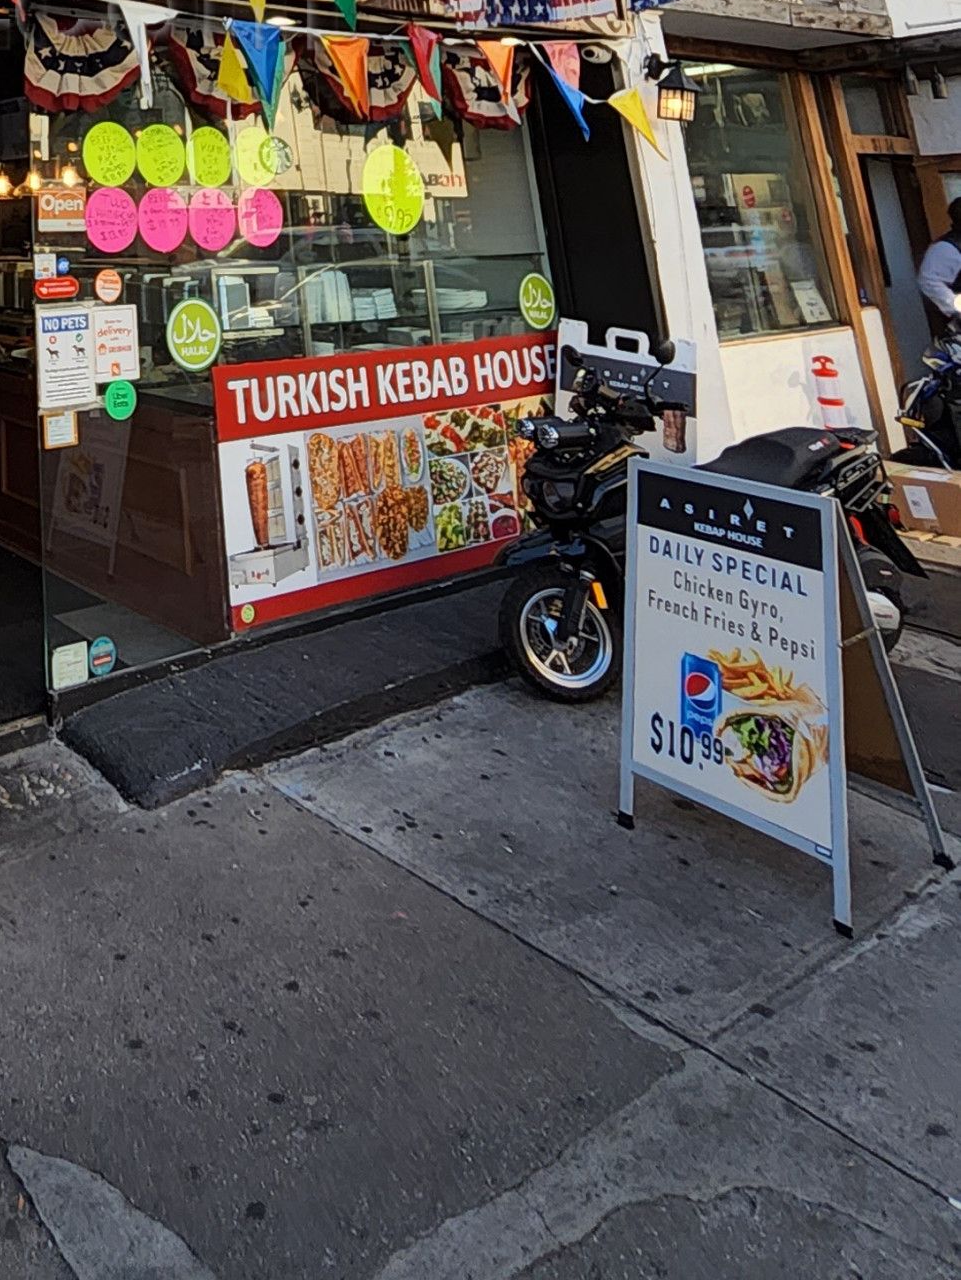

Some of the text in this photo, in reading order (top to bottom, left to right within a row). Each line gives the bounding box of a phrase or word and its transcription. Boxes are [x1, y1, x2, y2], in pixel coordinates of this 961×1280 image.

[41, 193, 84, 214] Open
[44, 315, 88, 332] NO PETS
[172, 313, 216, 344] حلال
[180, 345, 210, 358] HALAL
[227, 343, 556, 424] TURKISH KEBAB HOUSE
[659, 497, 796, 539] ASIRET
[694, 521, 764, 549] KEBAP HOUSE
[649, 535, 808, 597] DAILY SPECIAL
[673, 570, 784, 623] Chicken Gyro,
[648, 589, 816, 661] French Fries & Pepsi
